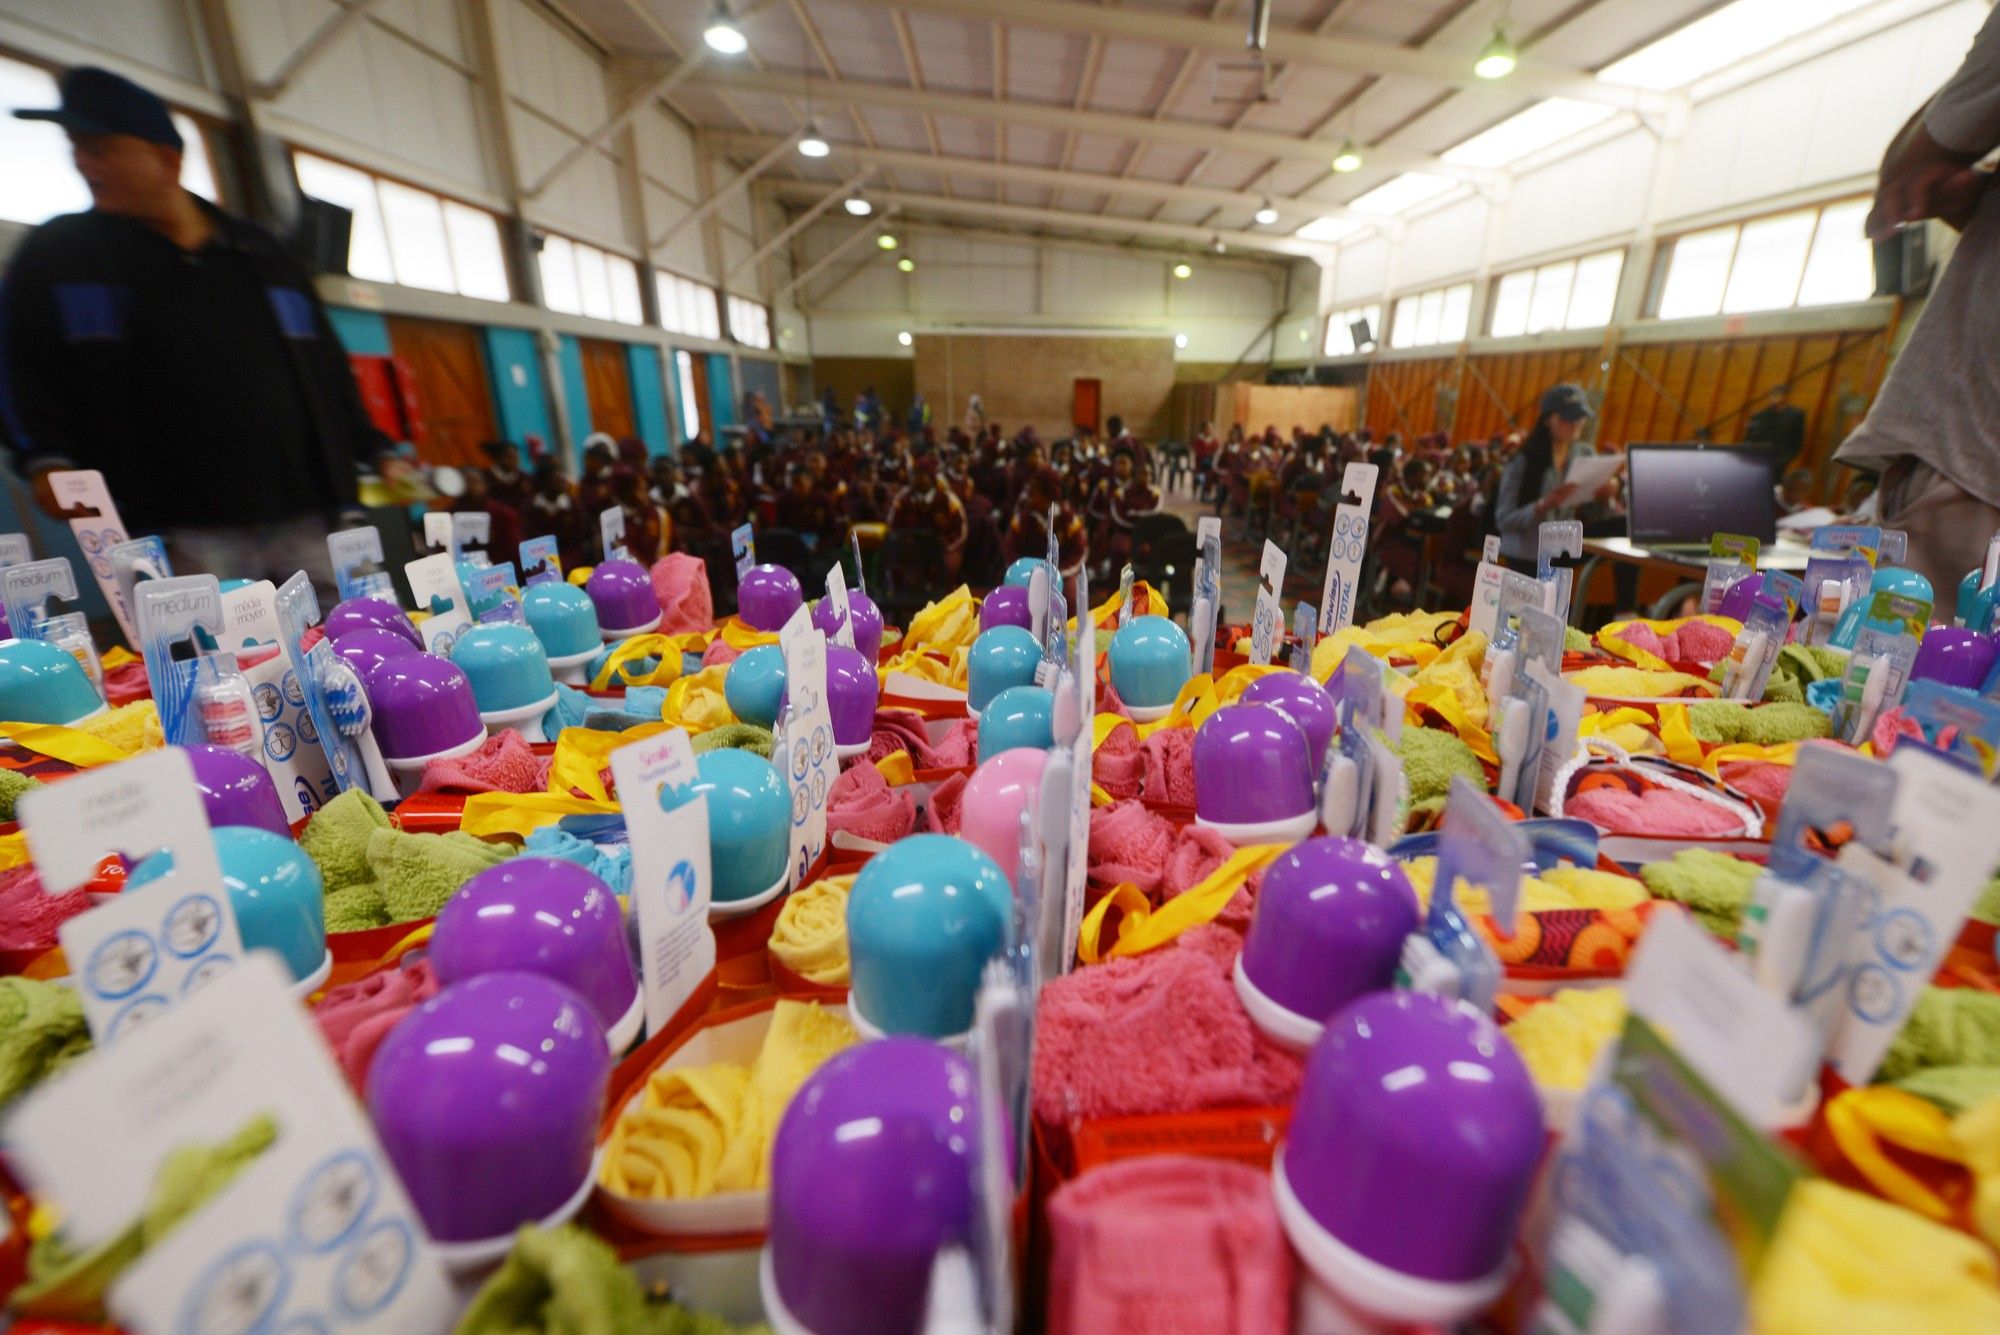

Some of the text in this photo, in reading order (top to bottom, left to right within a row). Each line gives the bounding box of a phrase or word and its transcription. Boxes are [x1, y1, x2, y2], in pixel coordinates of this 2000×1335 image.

[9, 571, 60, 590] medium
[152, 593, 210, 616] medium
[1340, 581, 1352, 622] TOTAL
